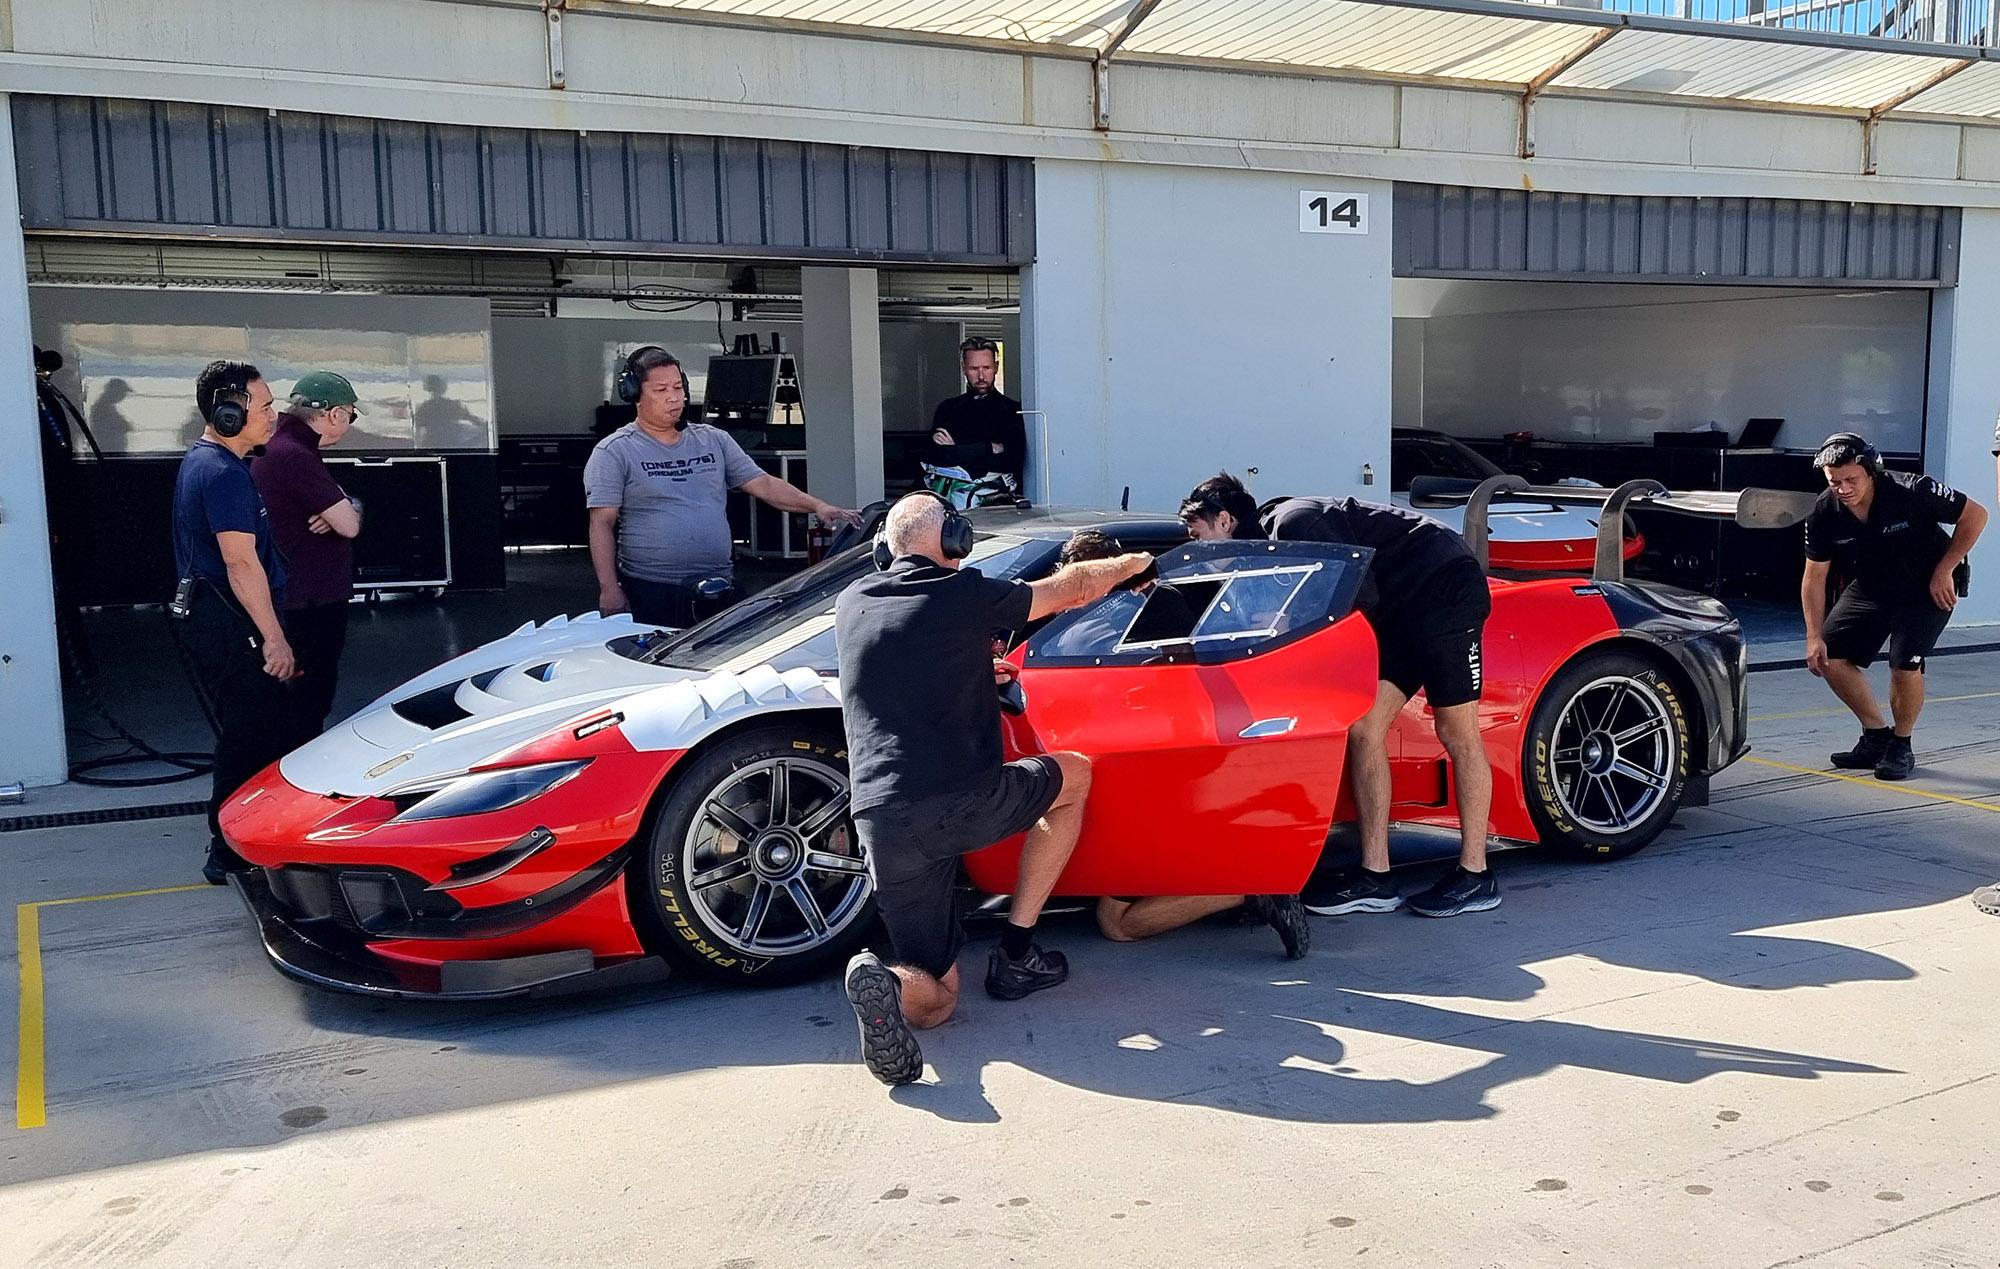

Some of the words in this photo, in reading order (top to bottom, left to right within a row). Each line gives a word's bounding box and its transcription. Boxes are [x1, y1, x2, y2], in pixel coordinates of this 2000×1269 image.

[1308, 197, 1361, 228] 14
[647, 467, 694, 477] PREMIUM
[1468, 653, 1481, 691] UNIT
[1656, 681, 1690, 777] PIRELLI
[661, 852, 676, 883] 5136
[659, 888, 738, 968] PIRELLI
